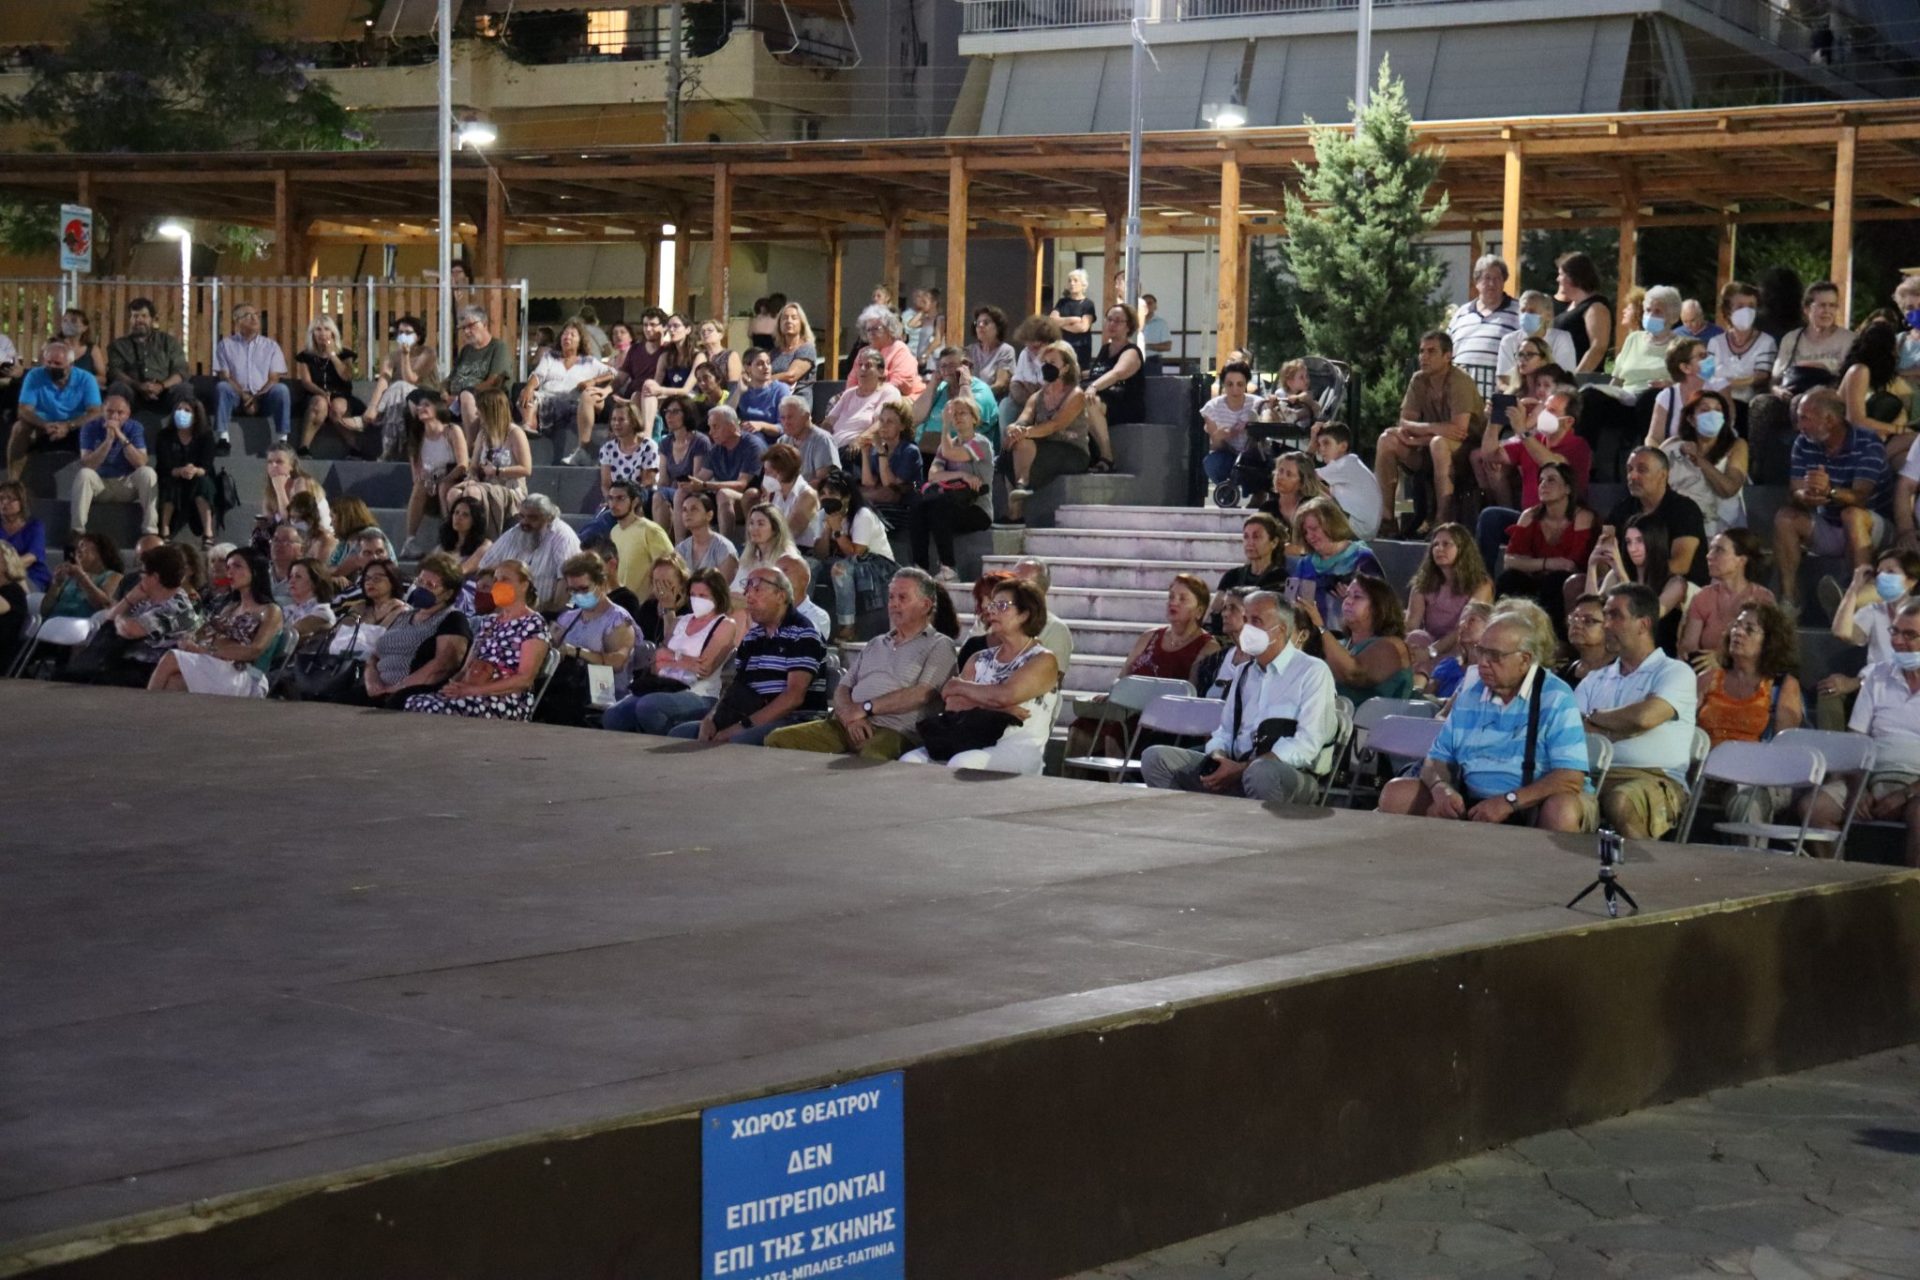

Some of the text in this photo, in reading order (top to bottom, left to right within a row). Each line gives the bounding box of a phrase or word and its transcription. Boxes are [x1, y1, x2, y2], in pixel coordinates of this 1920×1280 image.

[731, 1090, 880, 1139] ΧΩΡΟΣ ΘΕΑΤΡΟΥ
[787, 1143, 832, 1174] ΔΕΝ
[726, 1170, 885, 1230] ΕΠΙΤΡΕΠΟΝΤΑΙ
[714, 1208, 896, 1275] ΕΠΙ ΤΗΣ ΣΚΗΝΗΣ
